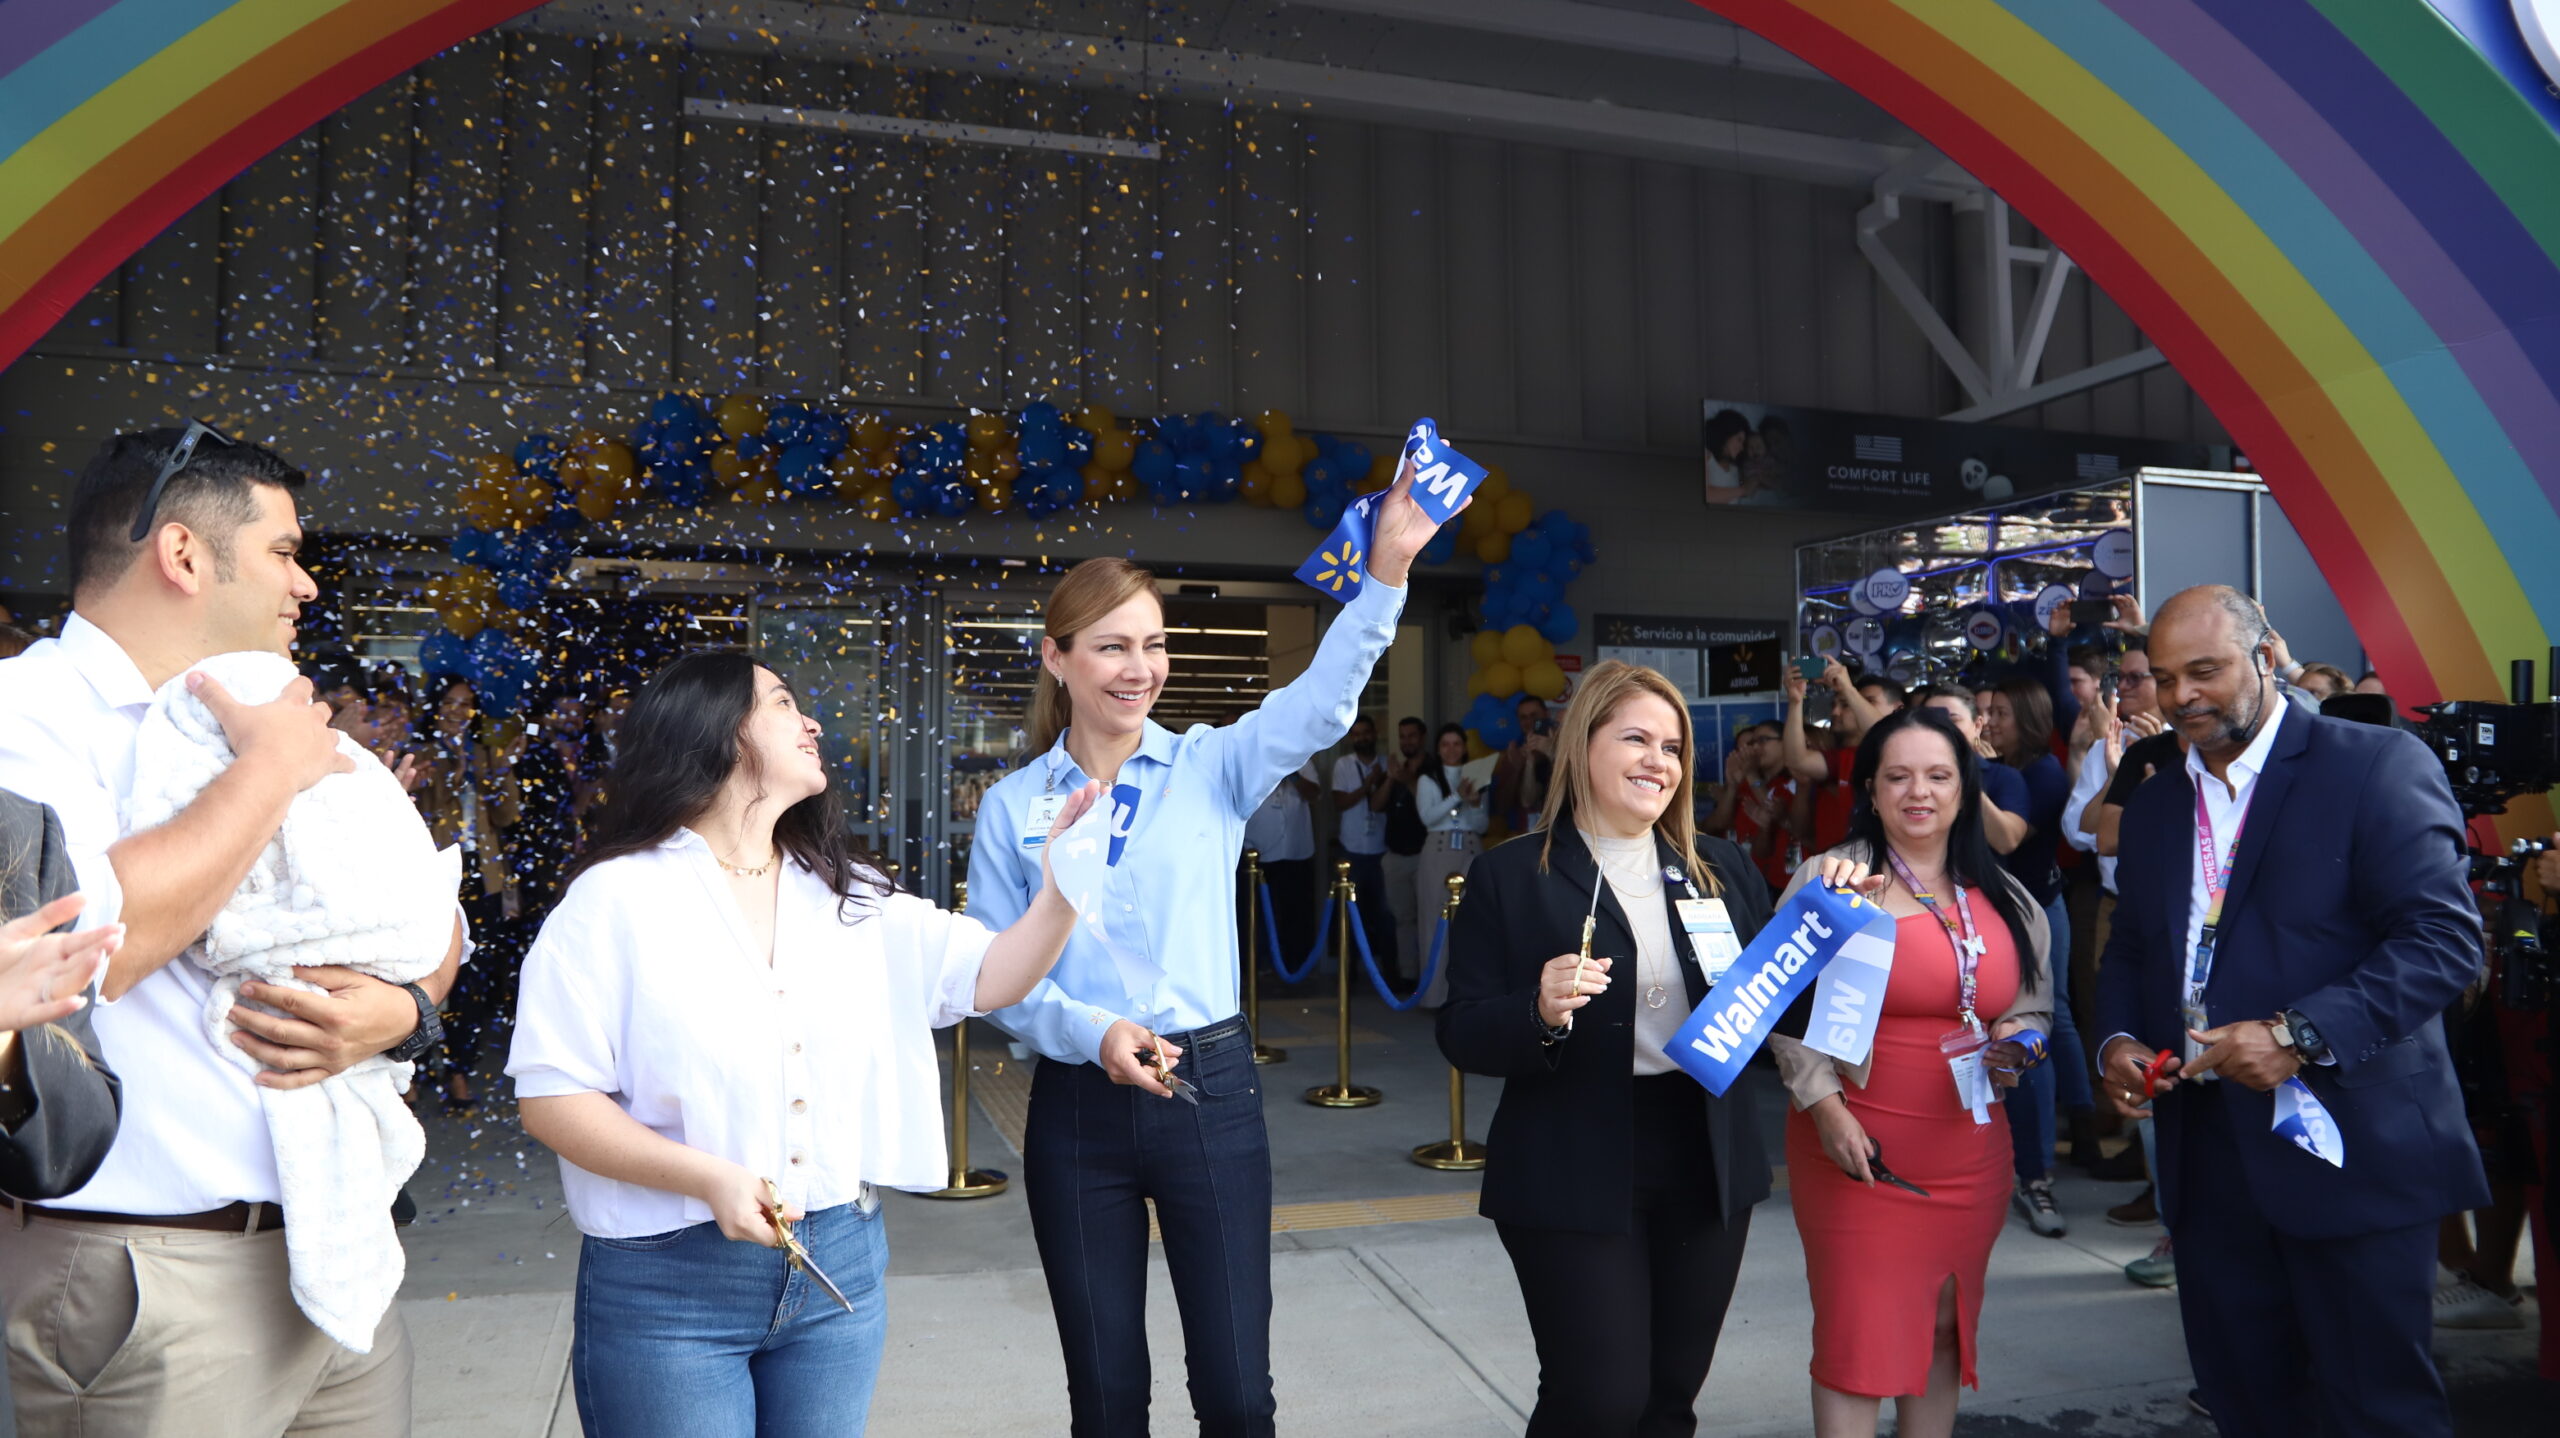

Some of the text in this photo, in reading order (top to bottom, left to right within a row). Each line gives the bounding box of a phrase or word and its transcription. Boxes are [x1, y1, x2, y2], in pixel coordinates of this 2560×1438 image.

[1827, 465, 1931, 486] COMFORT LIFE
[1633, 625, 1776, 642] Servicio a la comunidad
[1739, 663, 1749, 673] YA
[1730, 675, 1759, 689] ABRIMOS
[2201, 837, 2218, 894] REMESAS
[1691, 910, 1833, 1064] Walmart
